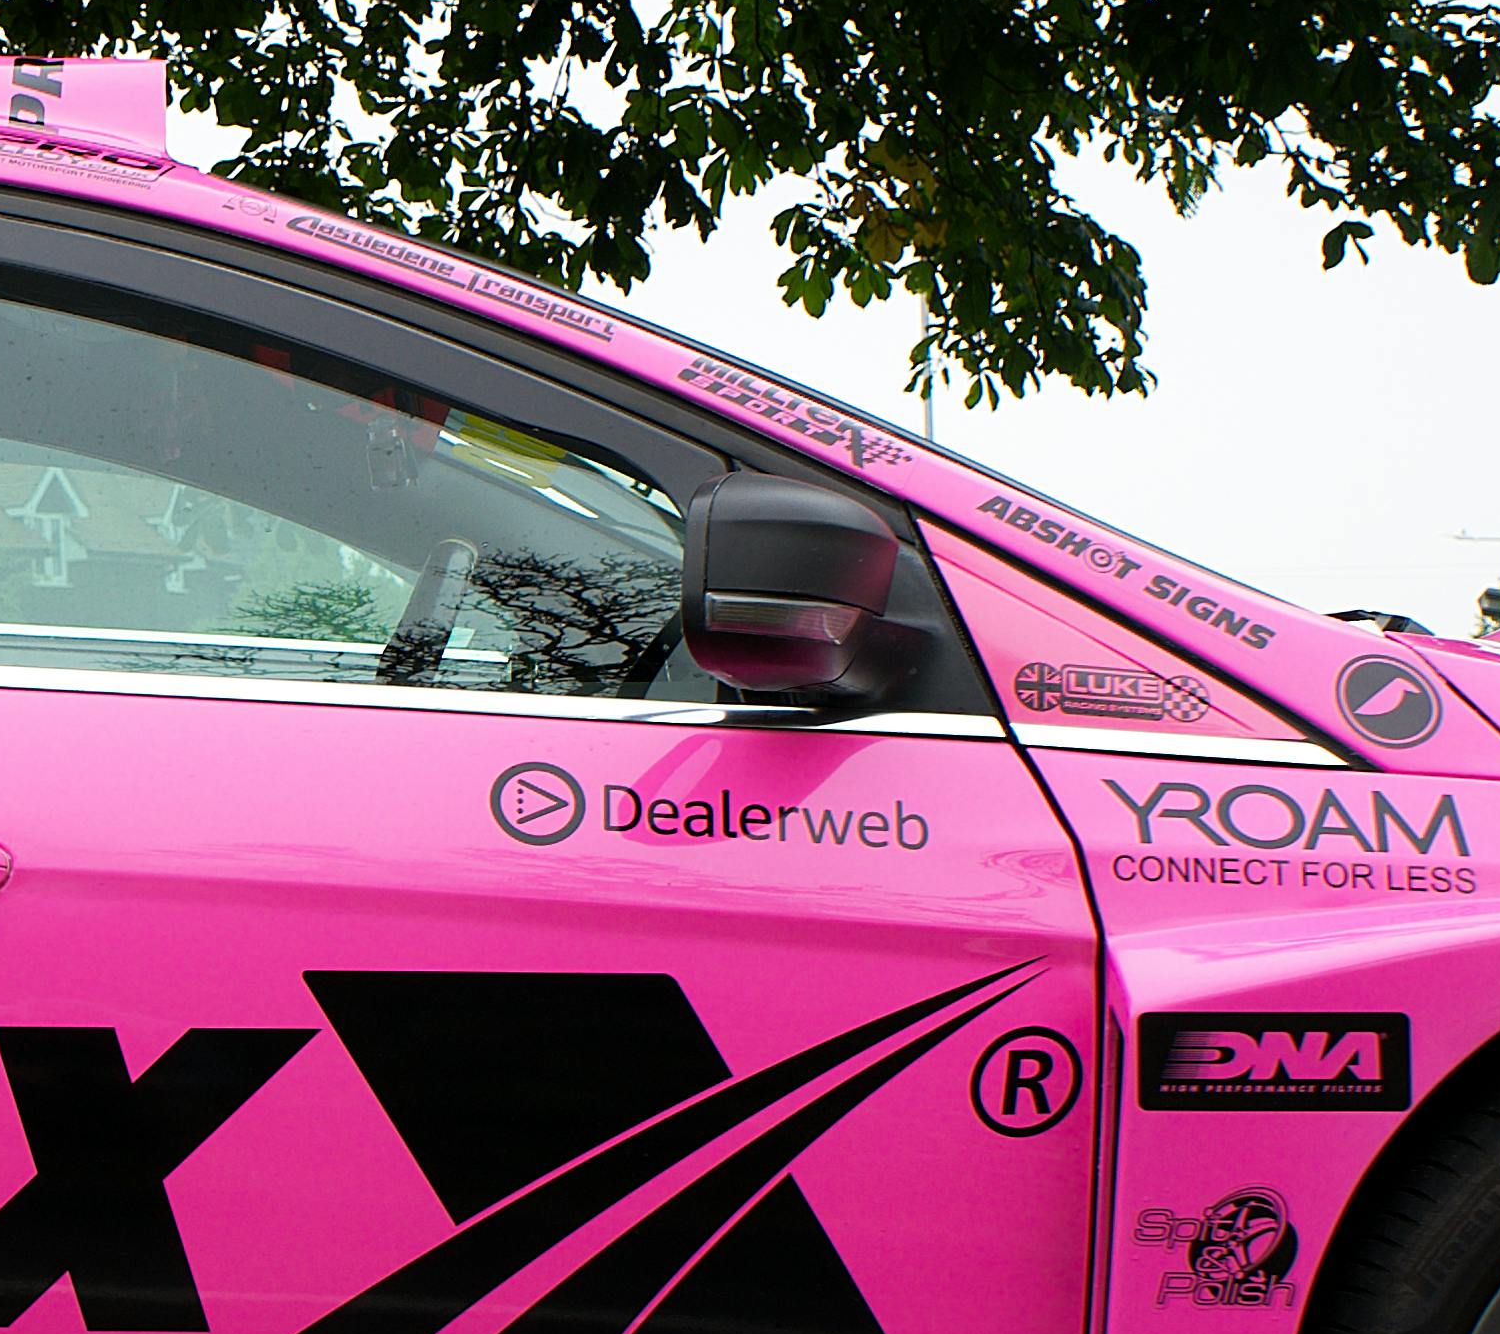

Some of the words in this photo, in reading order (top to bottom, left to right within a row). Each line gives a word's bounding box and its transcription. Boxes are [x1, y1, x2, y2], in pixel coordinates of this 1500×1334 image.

[286, 214, 456, 279] Castledene
[466, 269, 616, 340] Transport
[1143, 574, 1278, 650] SIGNS
[1068, 671, 1159, 698] LUKE
[602, 783, 929, 851] Dealerweb
[1111, 854, 1290, 889] CONNECT
[1300, 859, 1377, 893] FOR
[1384, 863, 1478, 896] LESS
[1160, 1030, 1384, 1080] DNA
[1159, 1084, 1198, 1093] HIGH
[1204, 1084, 1317, 1093] PERFORMANCE
[1322, 1084, 1384, 1093] FILTERS
[1134, 1208, 1236, 1250] Spit
[1156, 1267, 1296, 1307] Polish
